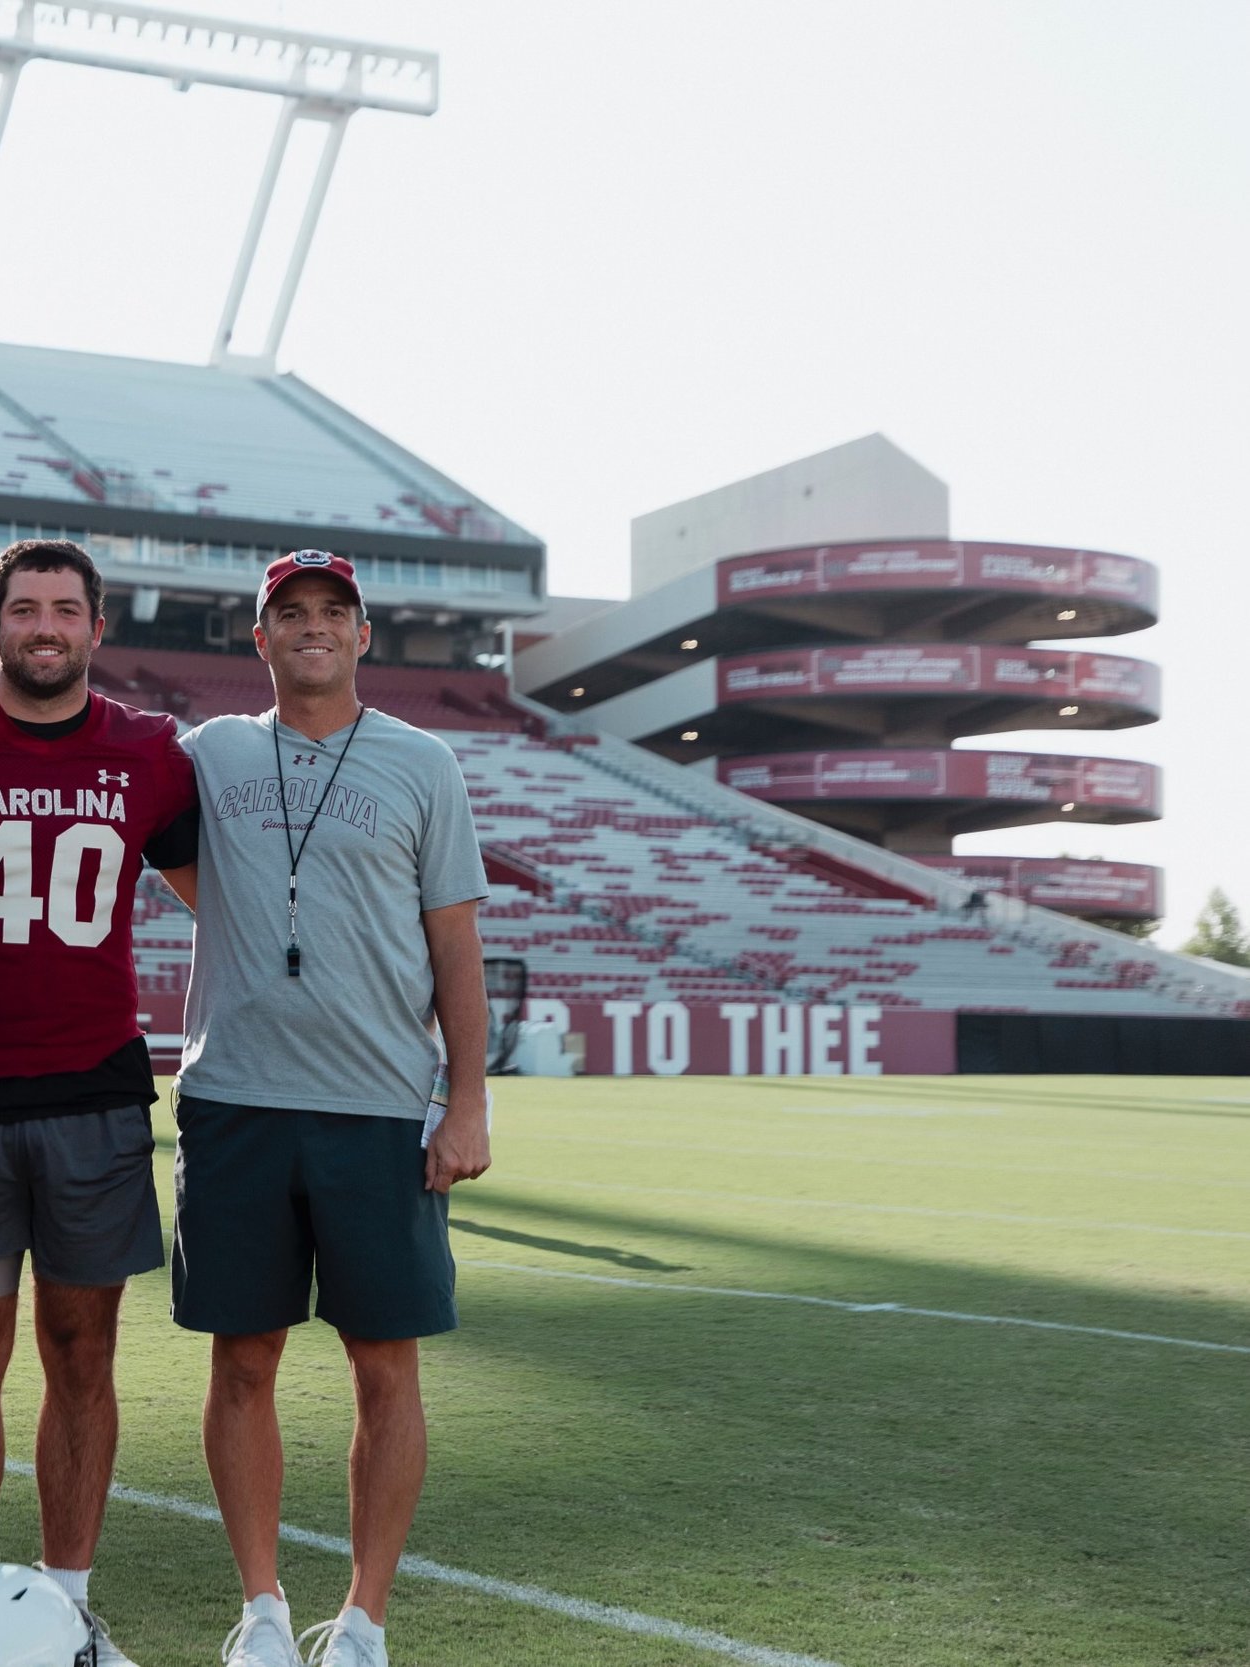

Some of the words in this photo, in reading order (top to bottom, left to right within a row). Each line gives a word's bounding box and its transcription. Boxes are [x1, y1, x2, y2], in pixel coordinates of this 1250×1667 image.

[215, 777, 378, 838] CAROLINA
[261, 817, 316, 831] Gamcocs
[602, 999, 691, 1077] TO
[719, 1002, 884, 1077] THEE
